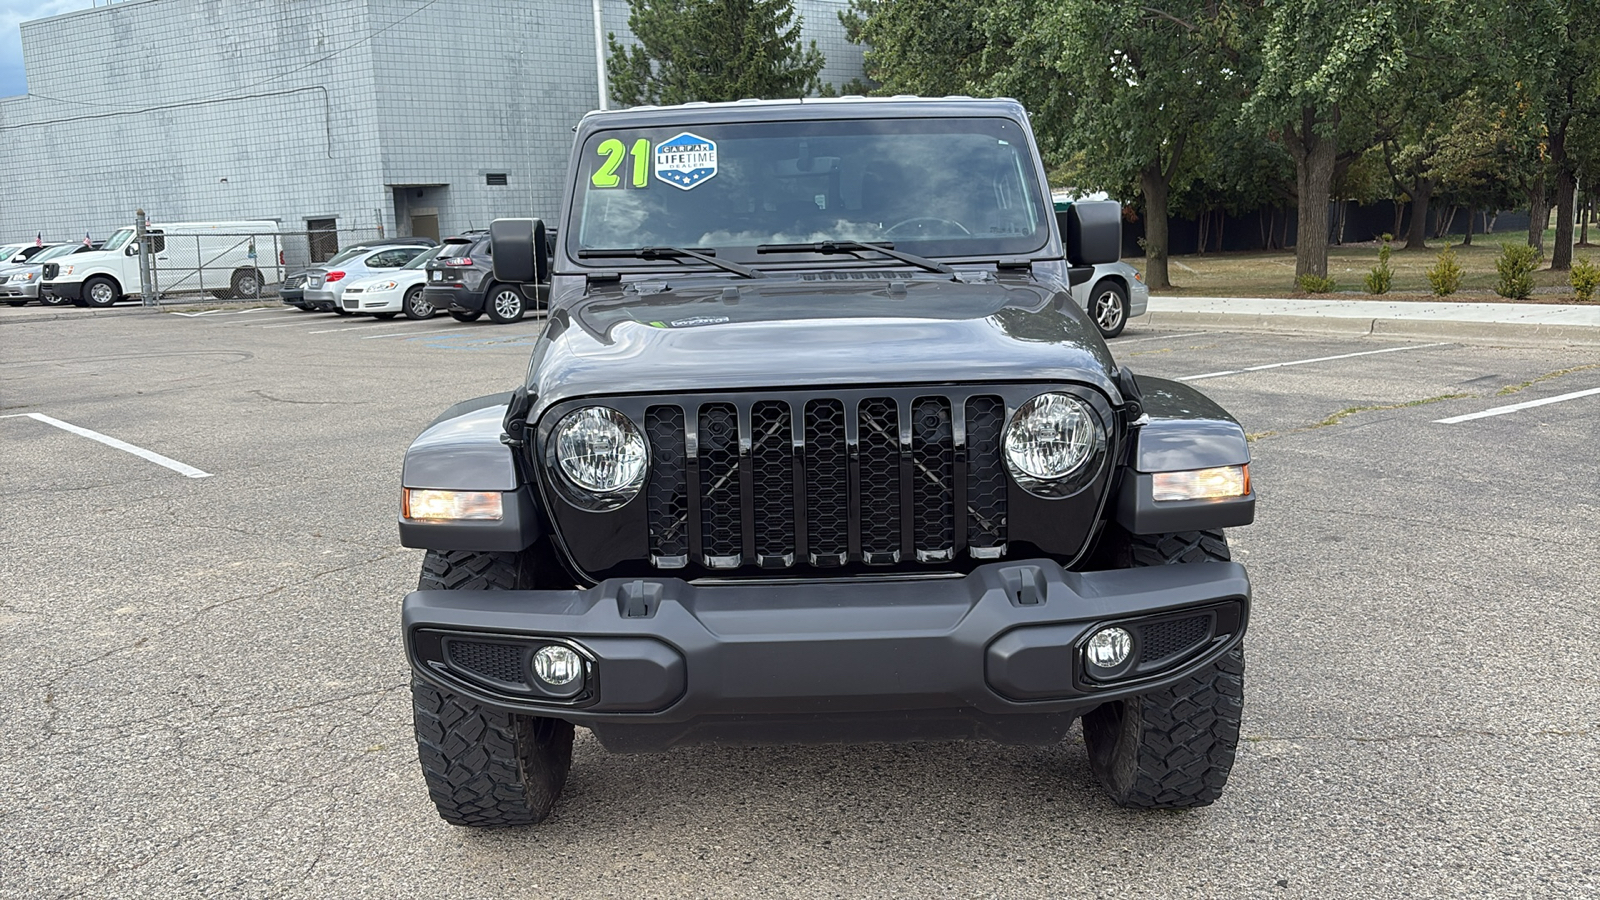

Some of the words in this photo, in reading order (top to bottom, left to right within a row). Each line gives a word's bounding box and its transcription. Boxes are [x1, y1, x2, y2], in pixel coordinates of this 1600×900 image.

[663, 144, 709, 153] CARFAX
[592, 138, 650, 188] 21
[657, 152, 715, 164] LIFETIME
